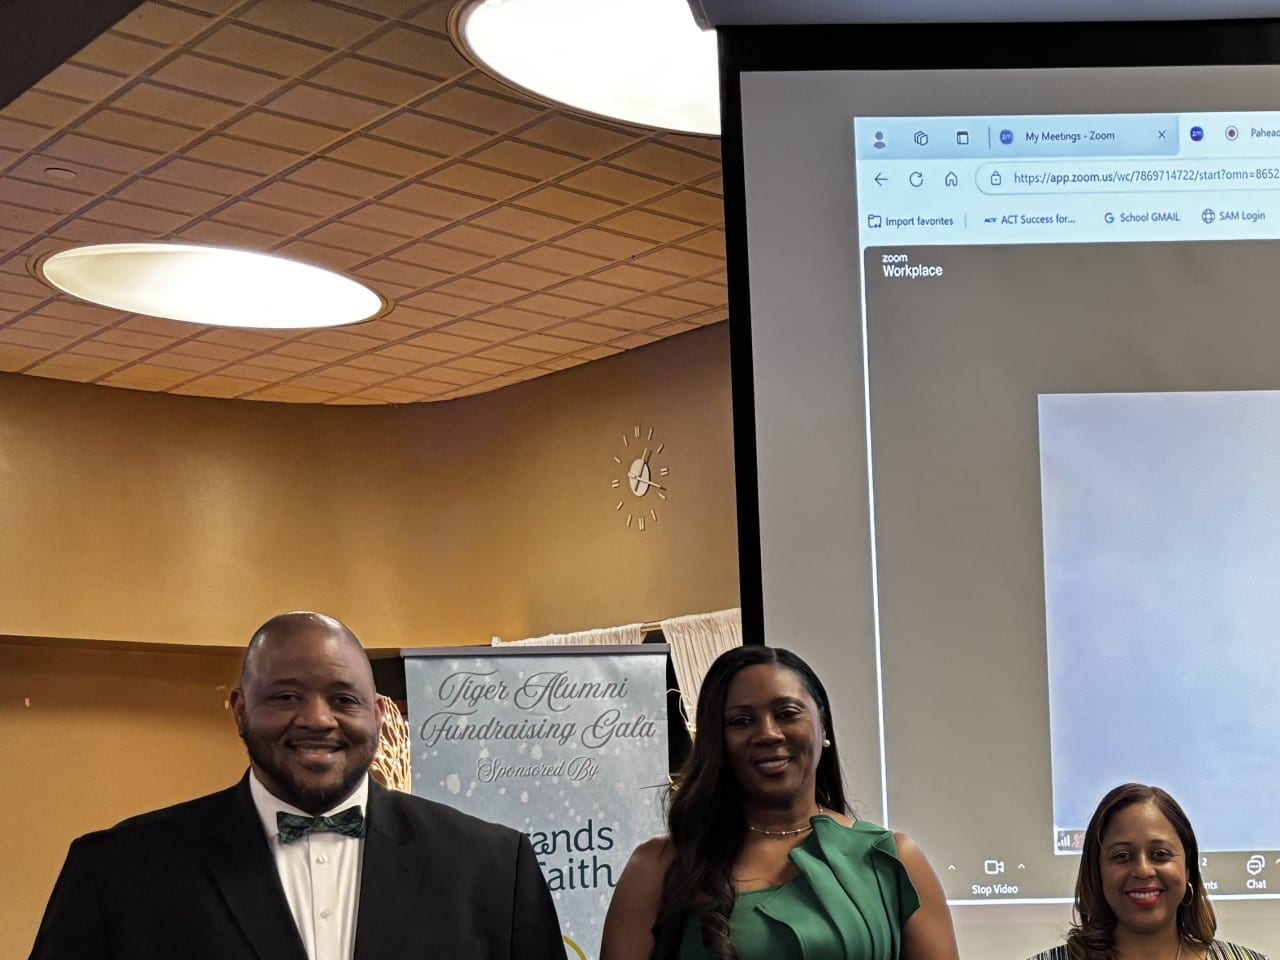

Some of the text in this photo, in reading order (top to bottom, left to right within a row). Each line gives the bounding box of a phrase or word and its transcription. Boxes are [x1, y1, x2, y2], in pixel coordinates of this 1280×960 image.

[1025, 131, 1039, 144] My
[1041, 131, 1081, 144] Meetings
[1089, 131, 1115, 141] Zoom
[885, 215, 954, 228] Import favorites
[1000, 214, 1019, 225] ACT
[1020, 214, 1053, 224] Success
[1120, 211, 1181, 223] School GMAIL
[1219, 210, 1266, 223] SAM Login
[881, 253, 908, 263] zoom
[882, 263, 943, 279] Workplace
[438, 669, 628, 712] Tiger Alumni
[420, 708, 656, 749] Fundraising Gala
[477, 756, 600, 783] Sponsored By
[525, 818, 614, 856] ands
[539, 855, 617, 891] aith
[971, 883, 1019, 896] Stop Video
[1246, 879, 1267, 889] Chat
